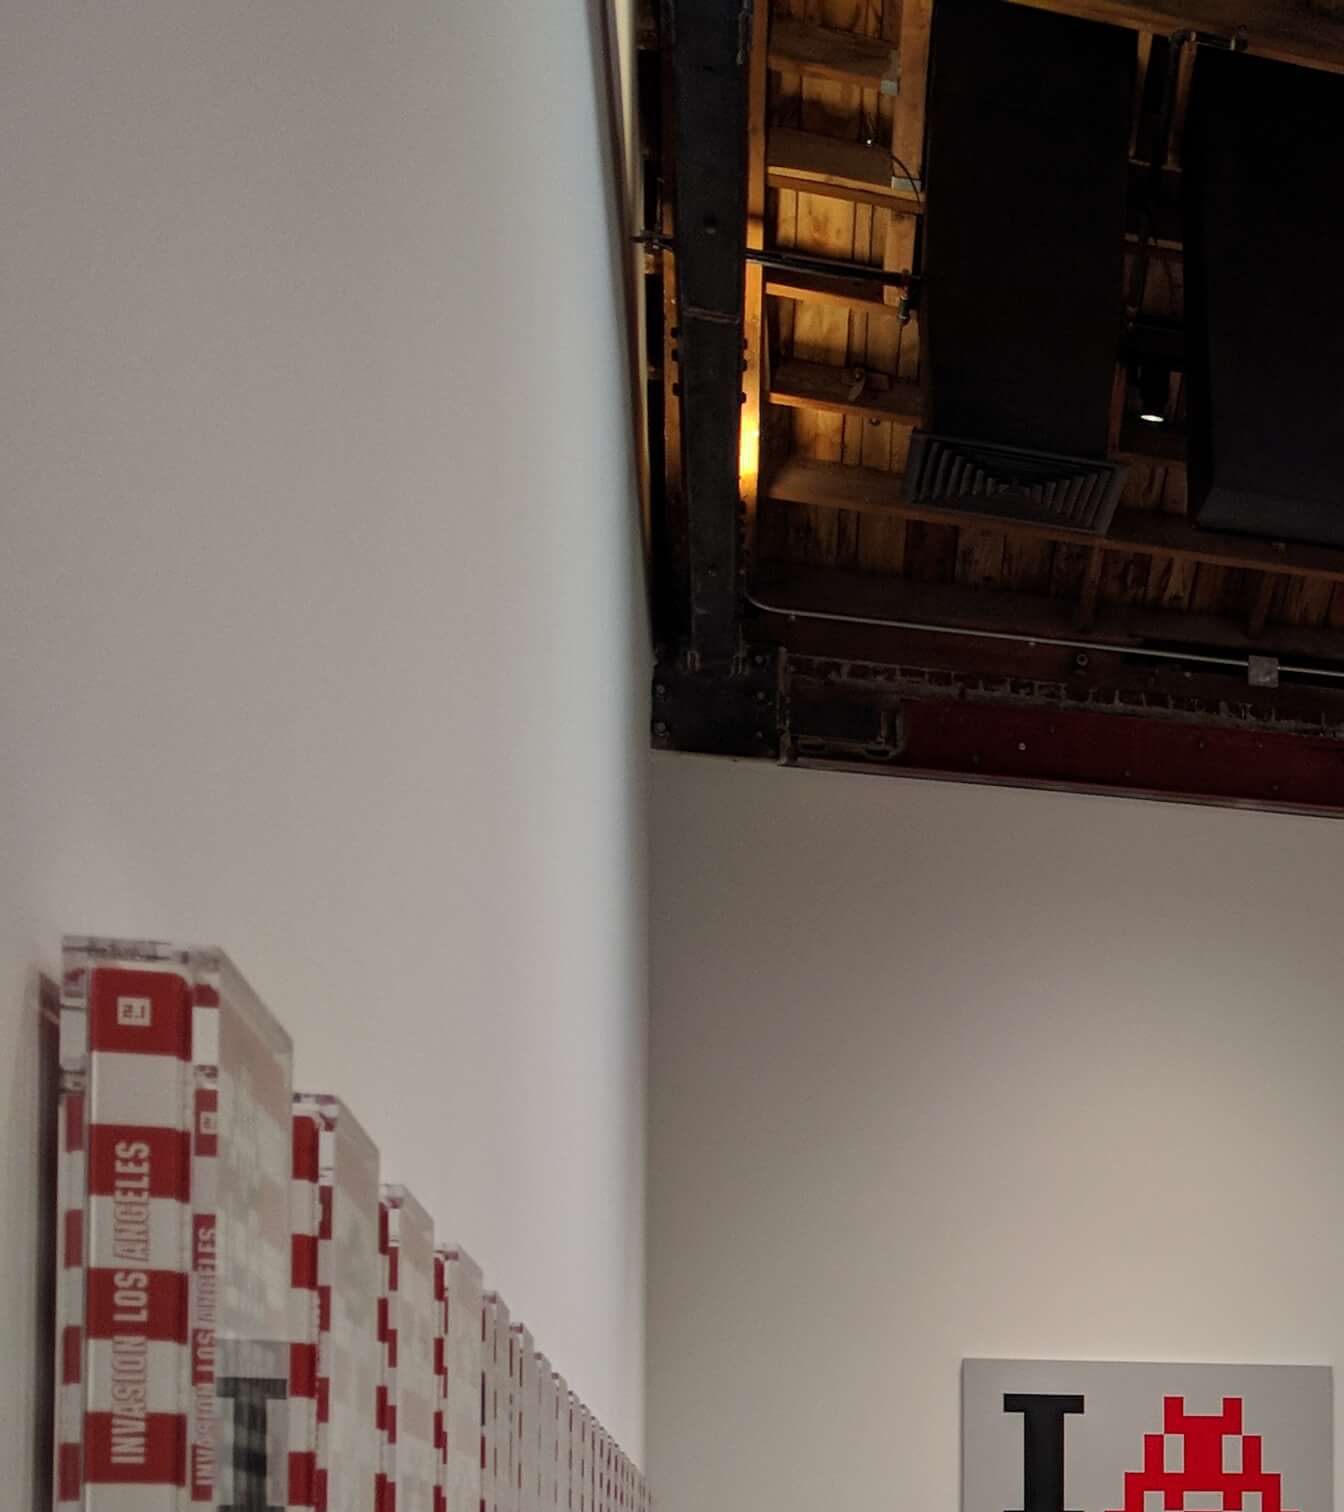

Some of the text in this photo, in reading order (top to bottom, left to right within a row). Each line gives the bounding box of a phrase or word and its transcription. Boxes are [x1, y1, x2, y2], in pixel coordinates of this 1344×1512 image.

[111, 1141, 150, 1464] INVASION LOS ANGELES
